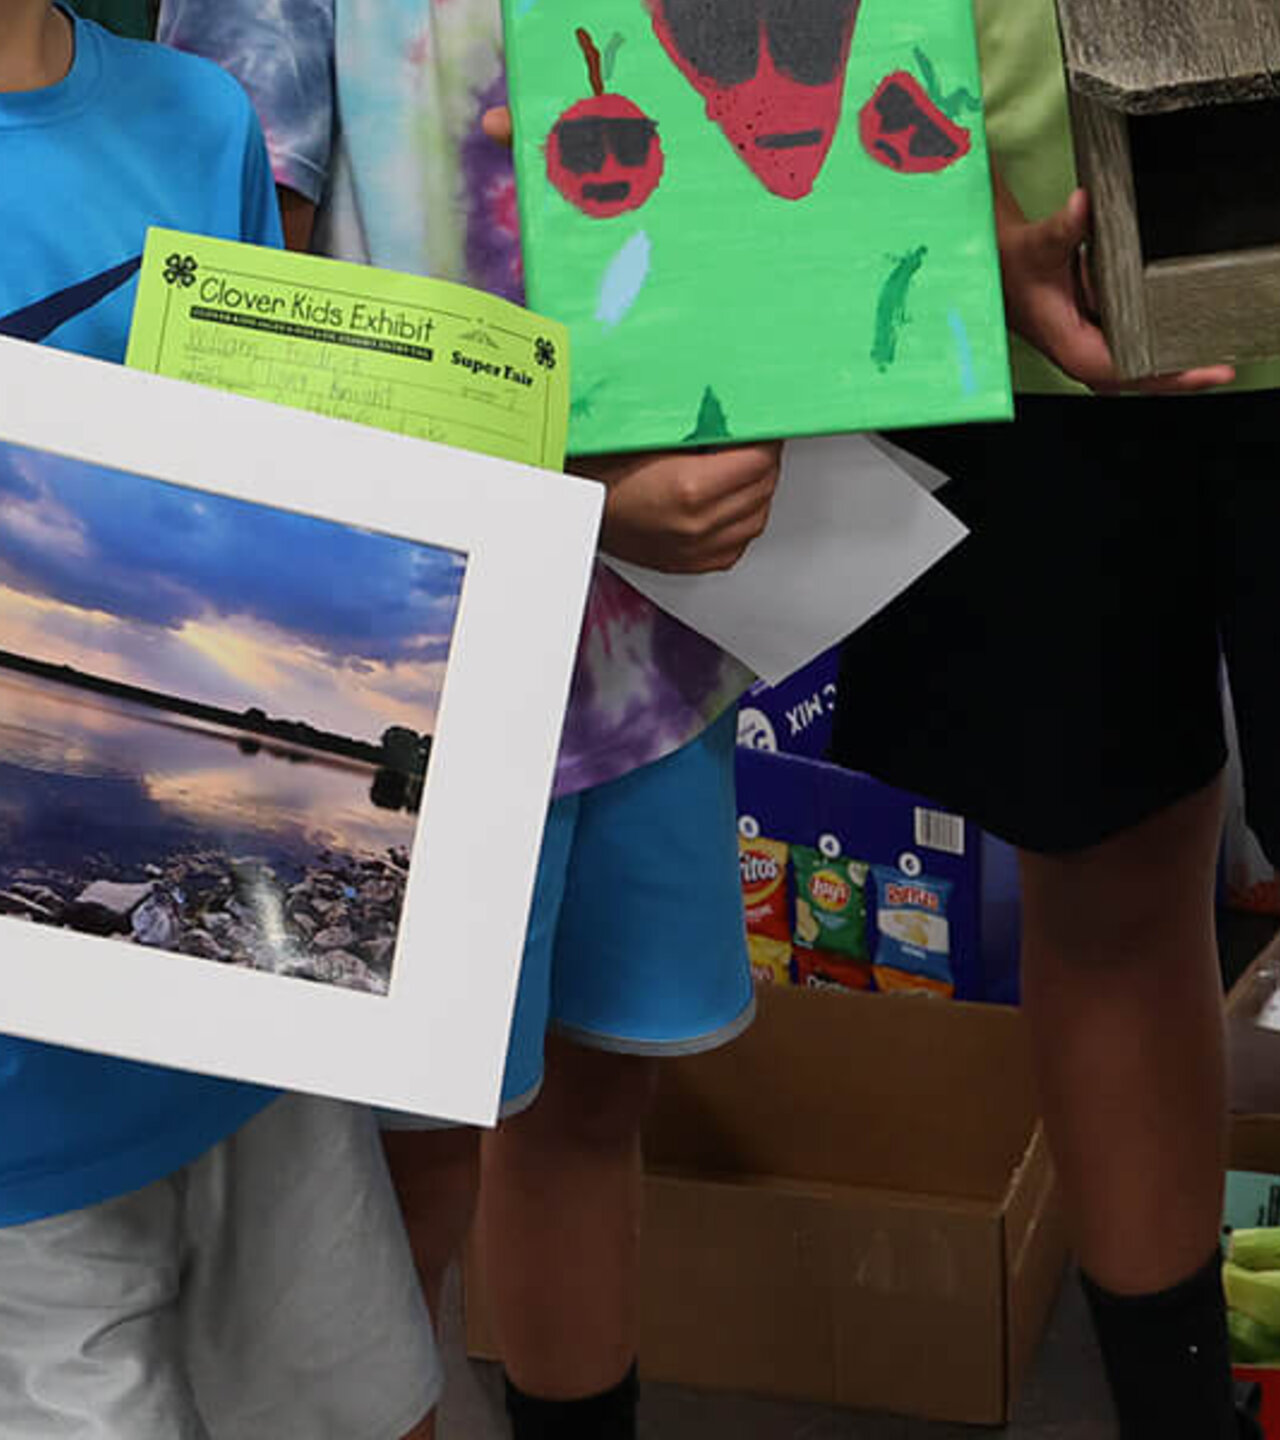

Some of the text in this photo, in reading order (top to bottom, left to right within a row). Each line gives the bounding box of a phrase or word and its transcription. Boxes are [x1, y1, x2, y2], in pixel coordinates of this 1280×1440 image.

[198, 276, 286, 316] Clover
[291, 291, 344, 328] Kids
[349, 303, 437, 344] Exhibit
[450, 350, 535, 389] Super Fair
[784, 691, 824, 736] MIX
[738, 850, 779, 883] ritos
